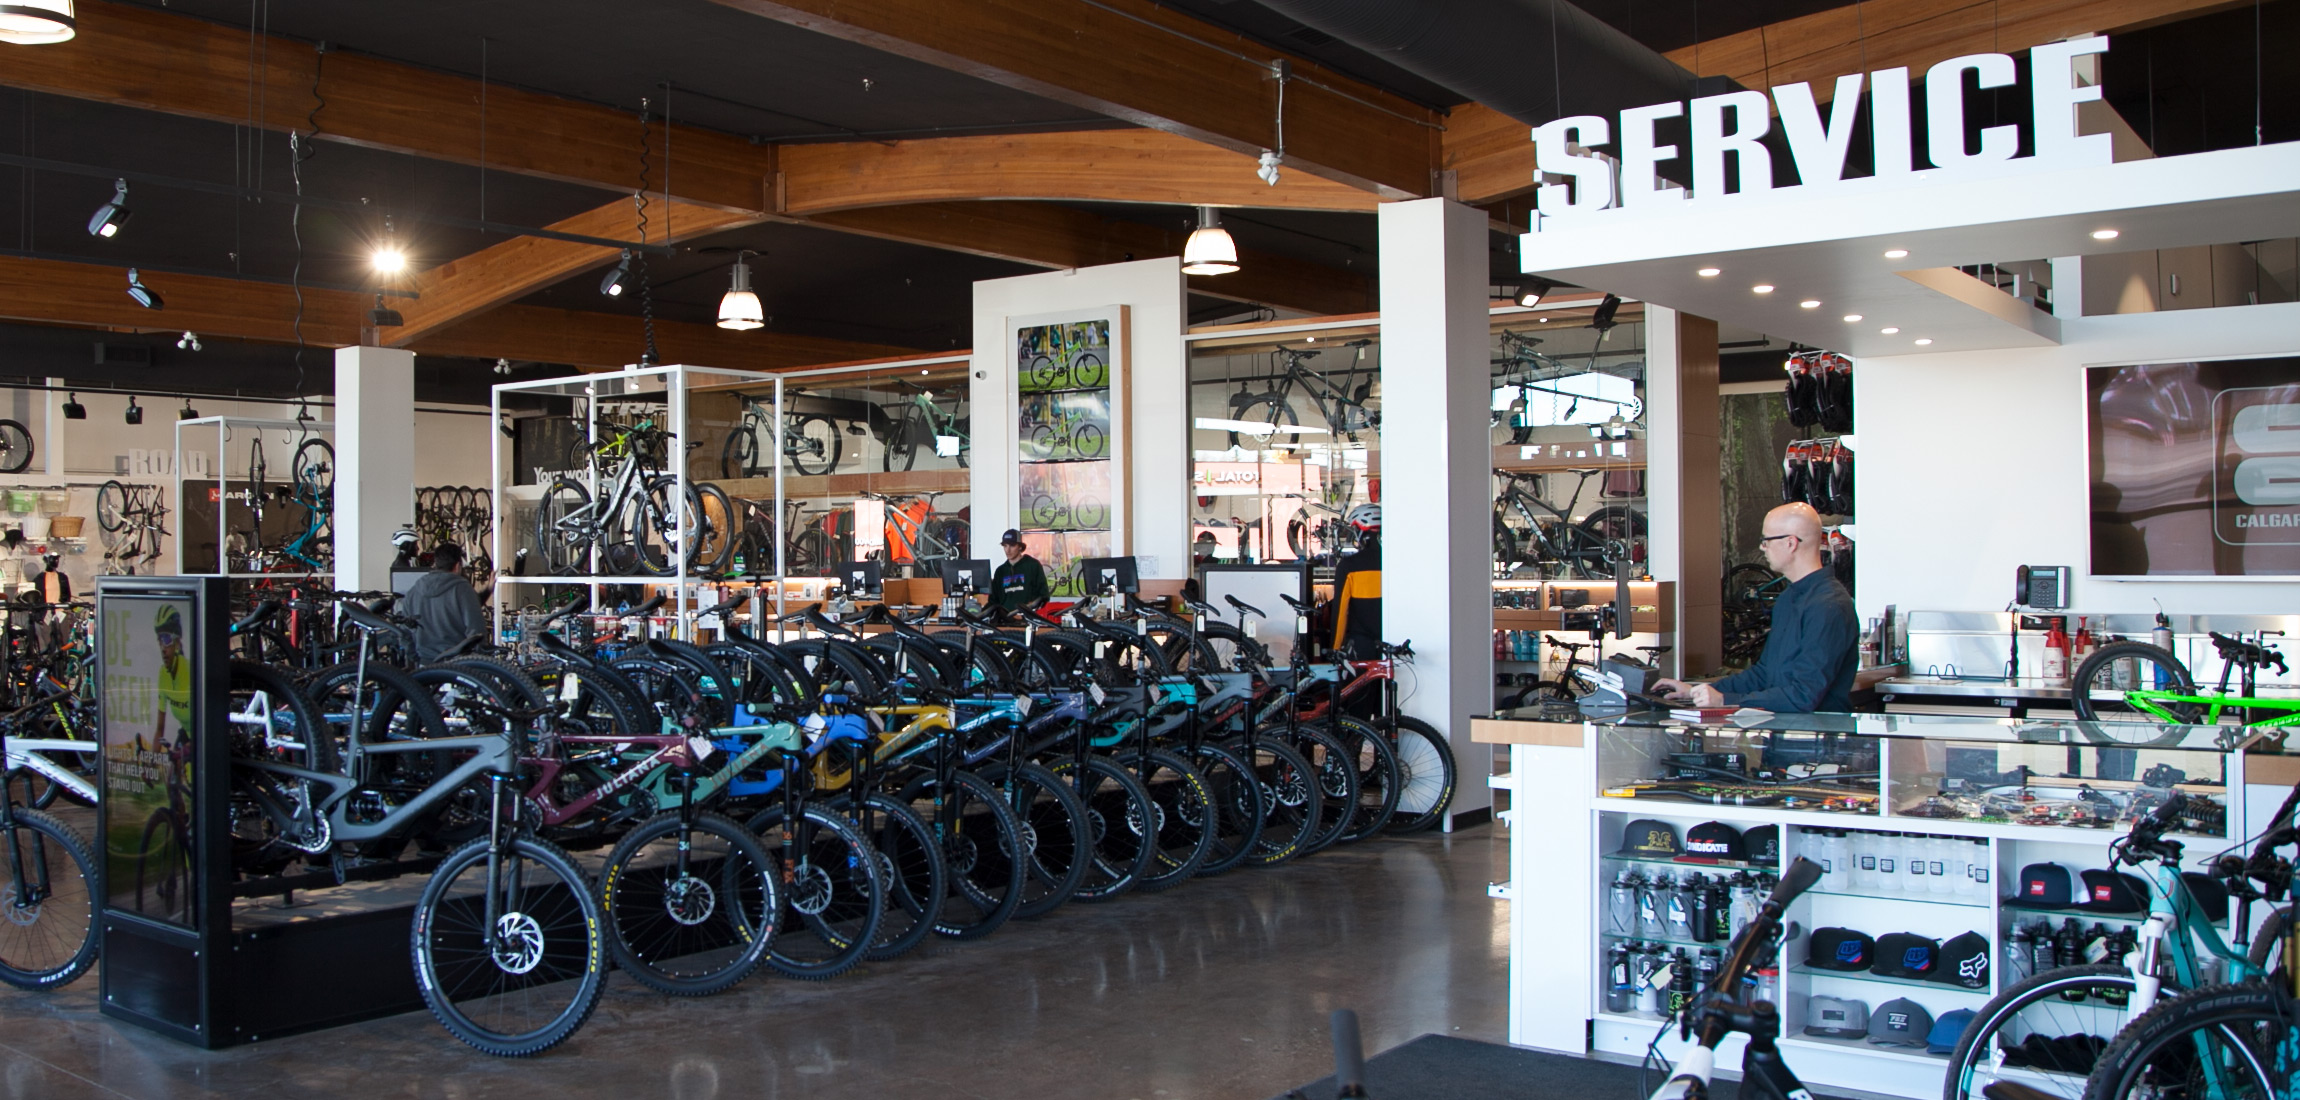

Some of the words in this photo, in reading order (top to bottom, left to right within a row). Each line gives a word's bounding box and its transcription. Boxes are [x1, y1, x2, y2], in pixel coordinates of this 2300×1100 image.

[1532, 35, 2113, 217] SERVICE
[129, 448, 208, 479] ROAD
[107, 609, 132, 667] BE
[107, 674, 152, 727] SEEN
[107, 746, 132, 761] LIGHTS
[1727, 754, 1737, 763] 3T
[107, 760, 126, 774] THAT
[126, 763, 144, 778] HELP
[145, 767, 159, 781] YOU
[595, 758, 662, 802] JULIANA
[107, 777, 131, 792] STAND
[131, 780, 146, 794] OUT
[678, 841, 690, 851] 34
[604, 864, 620, 912] MAXXIS
[932, 923, 962, 936] MAXX
[588, 918, 599, 973] MAXXIS
[40, 962, 77, 984] MAXXIS
[2184, 994, 2268, 1017] NOBBY
[2143, 1013, 2176, 1036] NIC
